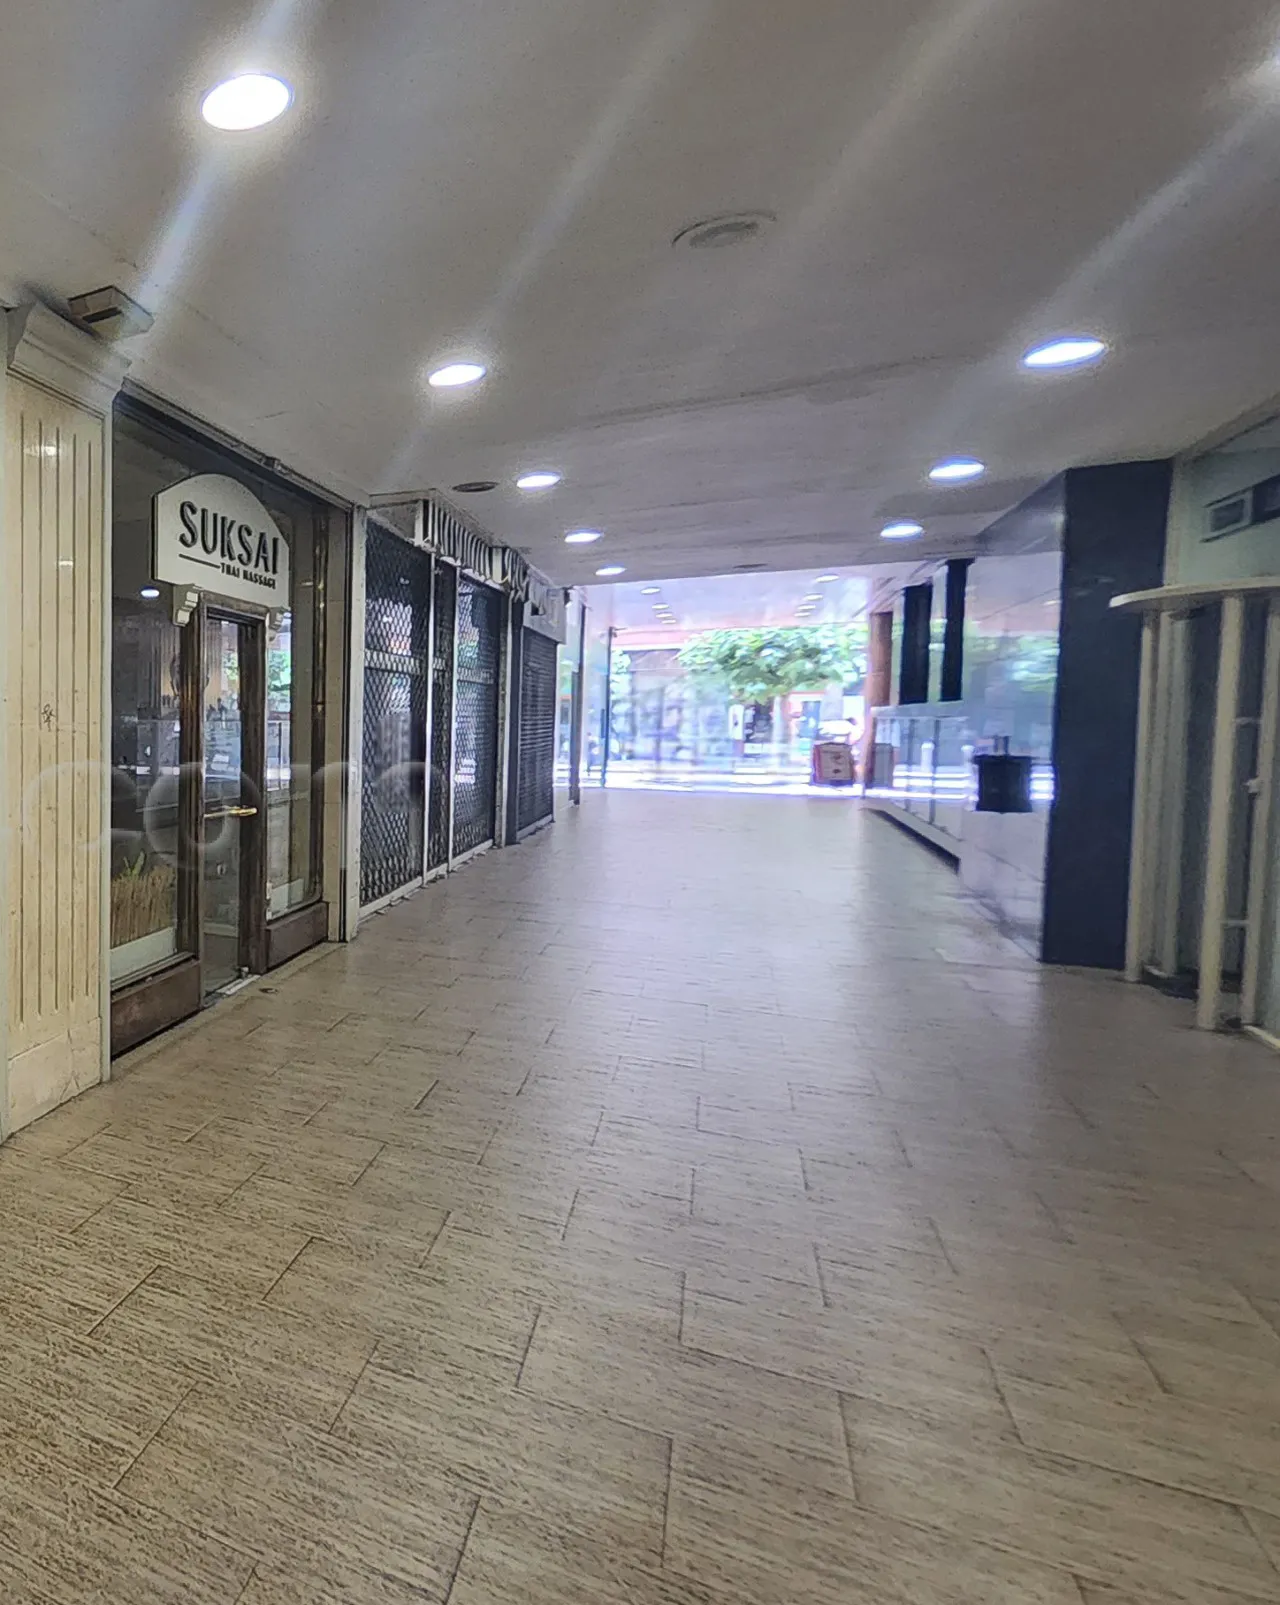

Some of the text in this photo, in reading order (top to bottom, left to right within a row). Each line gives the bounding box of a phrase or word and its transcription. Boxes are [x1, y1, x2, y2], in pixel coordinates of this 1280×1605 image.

[178, 500, 280, 576] SUKSAI
[220, 562, 277, 590] THAI MASSAGE
